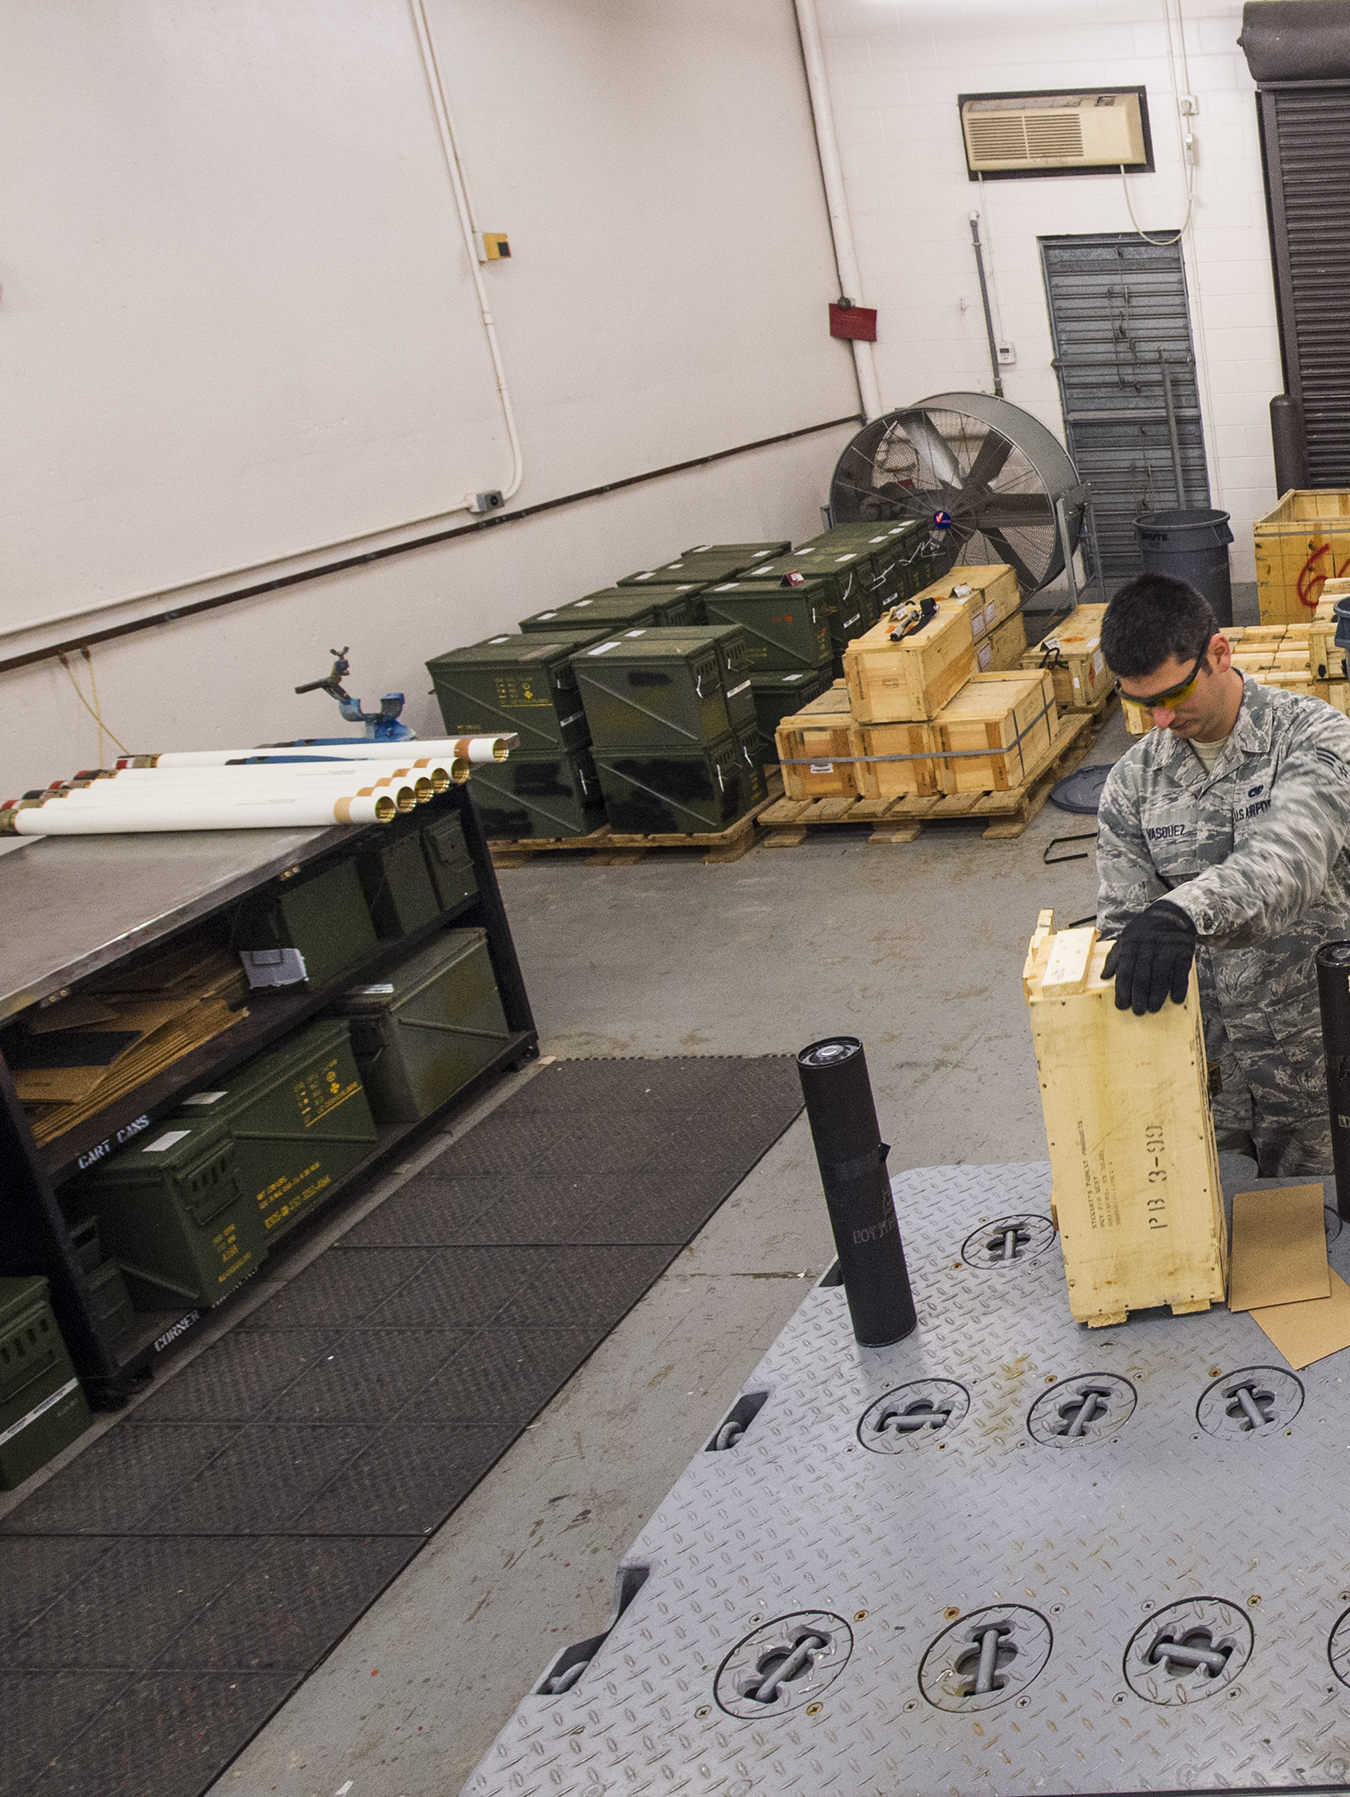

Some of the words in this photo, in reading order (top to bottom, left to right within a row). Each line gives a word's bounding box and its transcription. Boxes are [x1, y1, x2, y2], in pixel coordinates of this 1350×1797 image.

[1145, 824, 1185, 841] VASQUEZ
[78, 1139, 112, 1169] CART
[116, 1114, 150, 1143] CANS
[1145, 1125, 1168, 1183] 3-99
[1147, 1198, 1168, 1230] PB
[154, 1309, 200, 1352] CORNER
